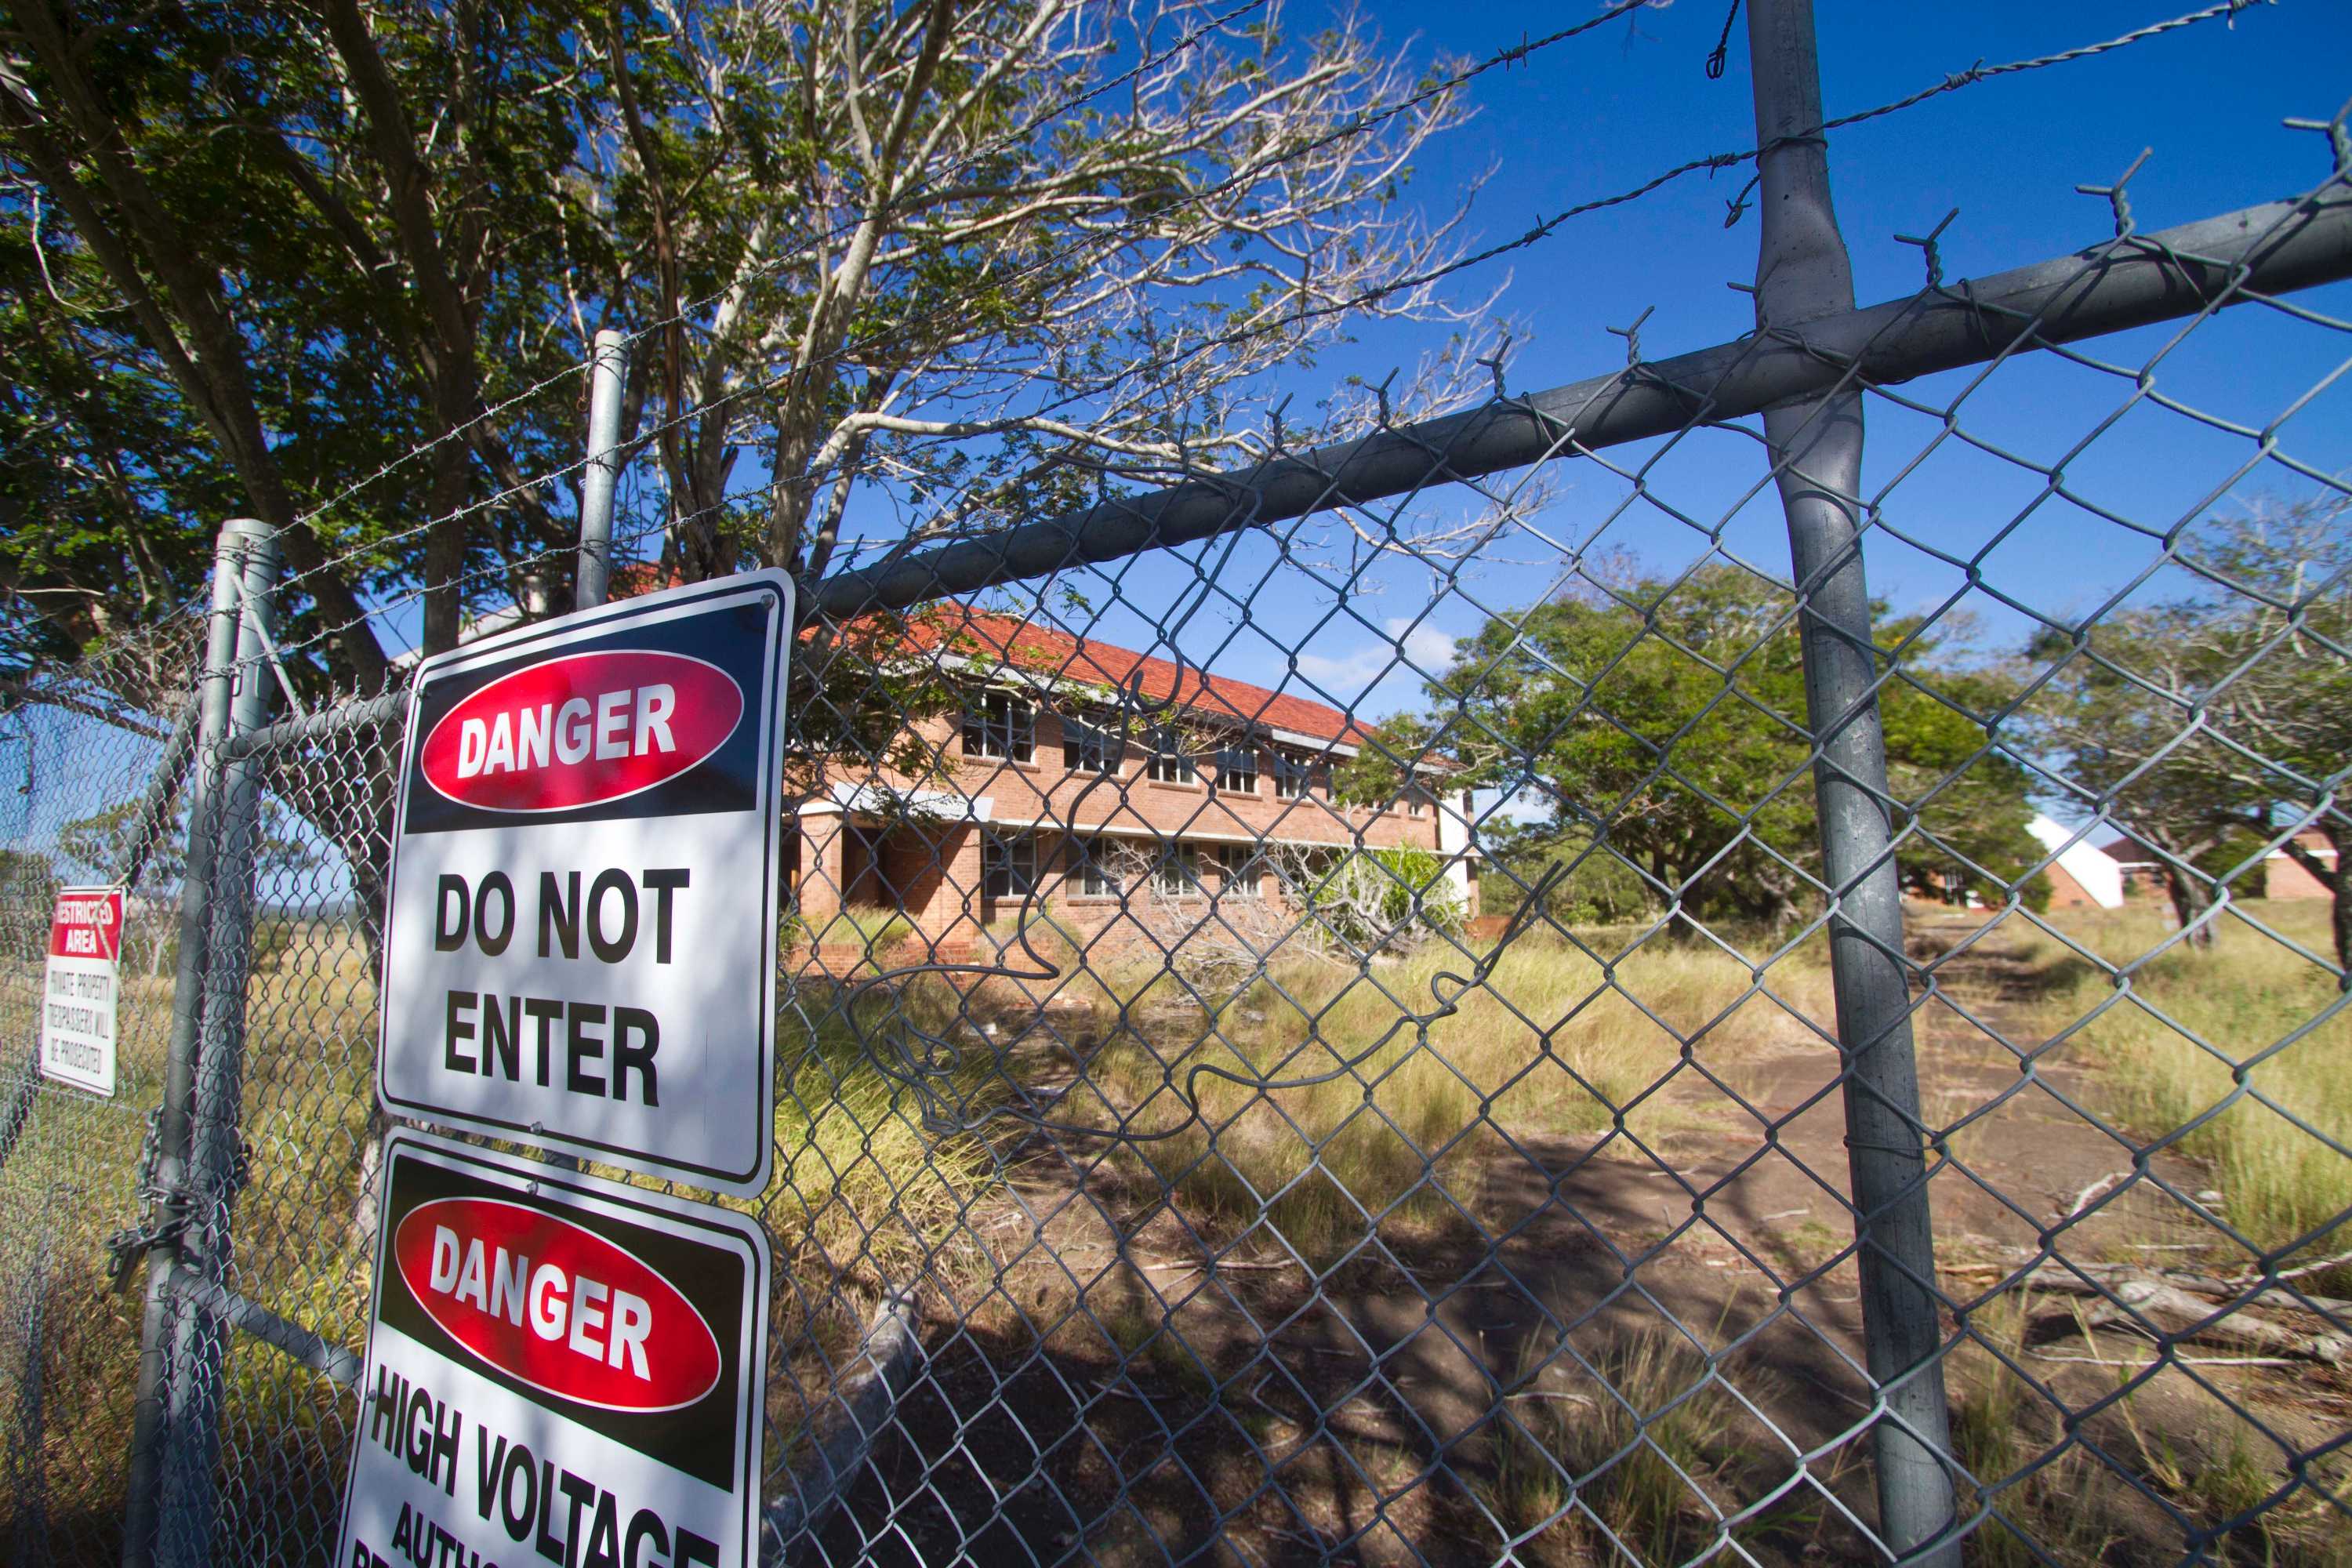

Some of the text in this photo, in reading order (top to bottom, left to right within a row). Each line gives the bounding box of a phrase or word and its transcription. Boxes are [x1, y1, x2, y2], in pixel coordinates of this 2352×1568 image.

[456, 684, 677, 779] DANGER
[64, 928, 97, 953] AREA
[434, 868, 690, 964] DO NOT
[51, 1037, 59, 1062] BE
[445, 989, 660, 1108] ENTER
[429, 1224, 652, 1382] DANGER
[371, 1363, 463, 1497] HIGH
